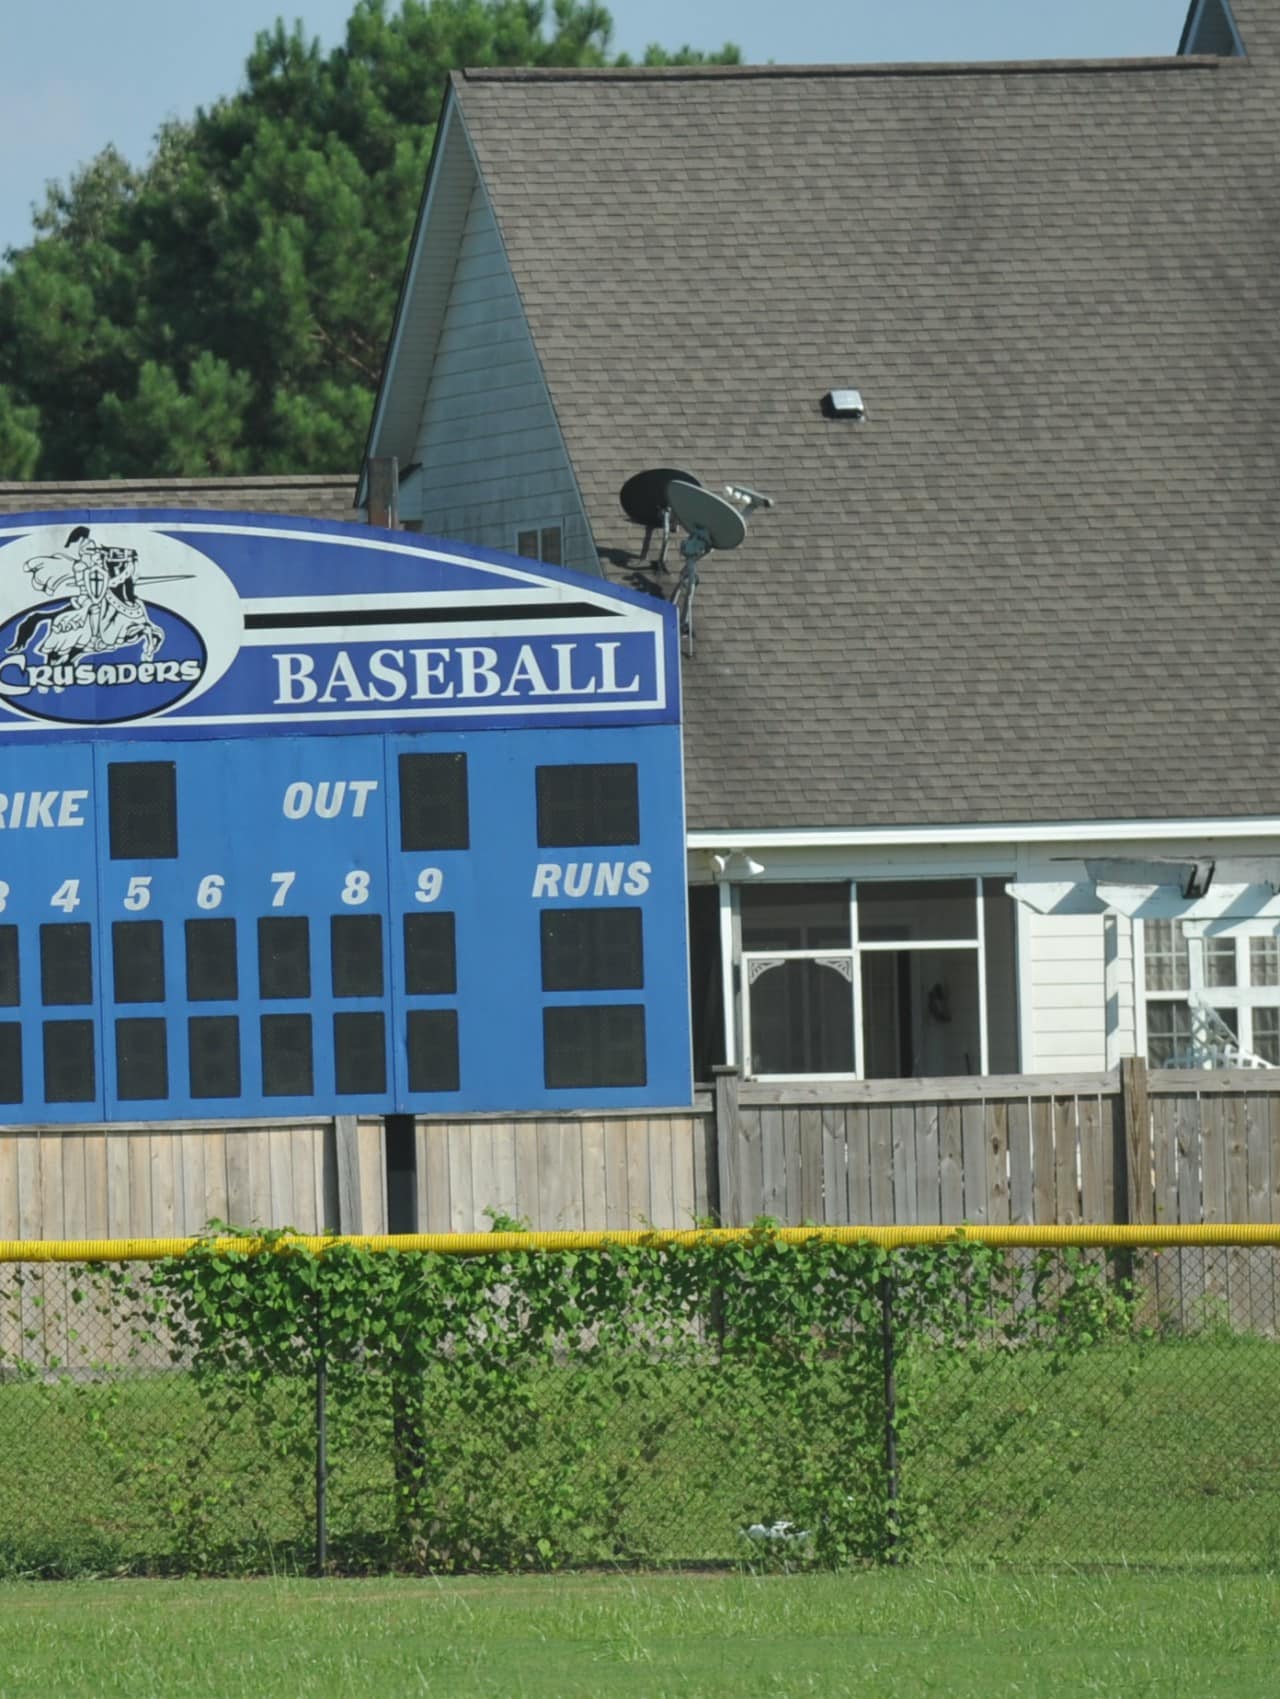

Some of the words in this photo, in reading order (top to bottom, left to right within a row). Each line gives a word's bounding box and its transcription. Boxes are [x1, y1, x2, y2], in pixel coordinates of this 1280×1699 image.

[272, 642, 640, 705] BASEBALL
[282, 780, 378, 819] OUT
[50, 879, 80, 913] 4
[123, 876, 152, 911] 5
[196, 874, 225, 909] 6
[270, 871, 296, 907] 7
[341, 869, 370, 905] 8
[415, 867, 444, 902] 9
[531, 860, 652, 898] RUNS
